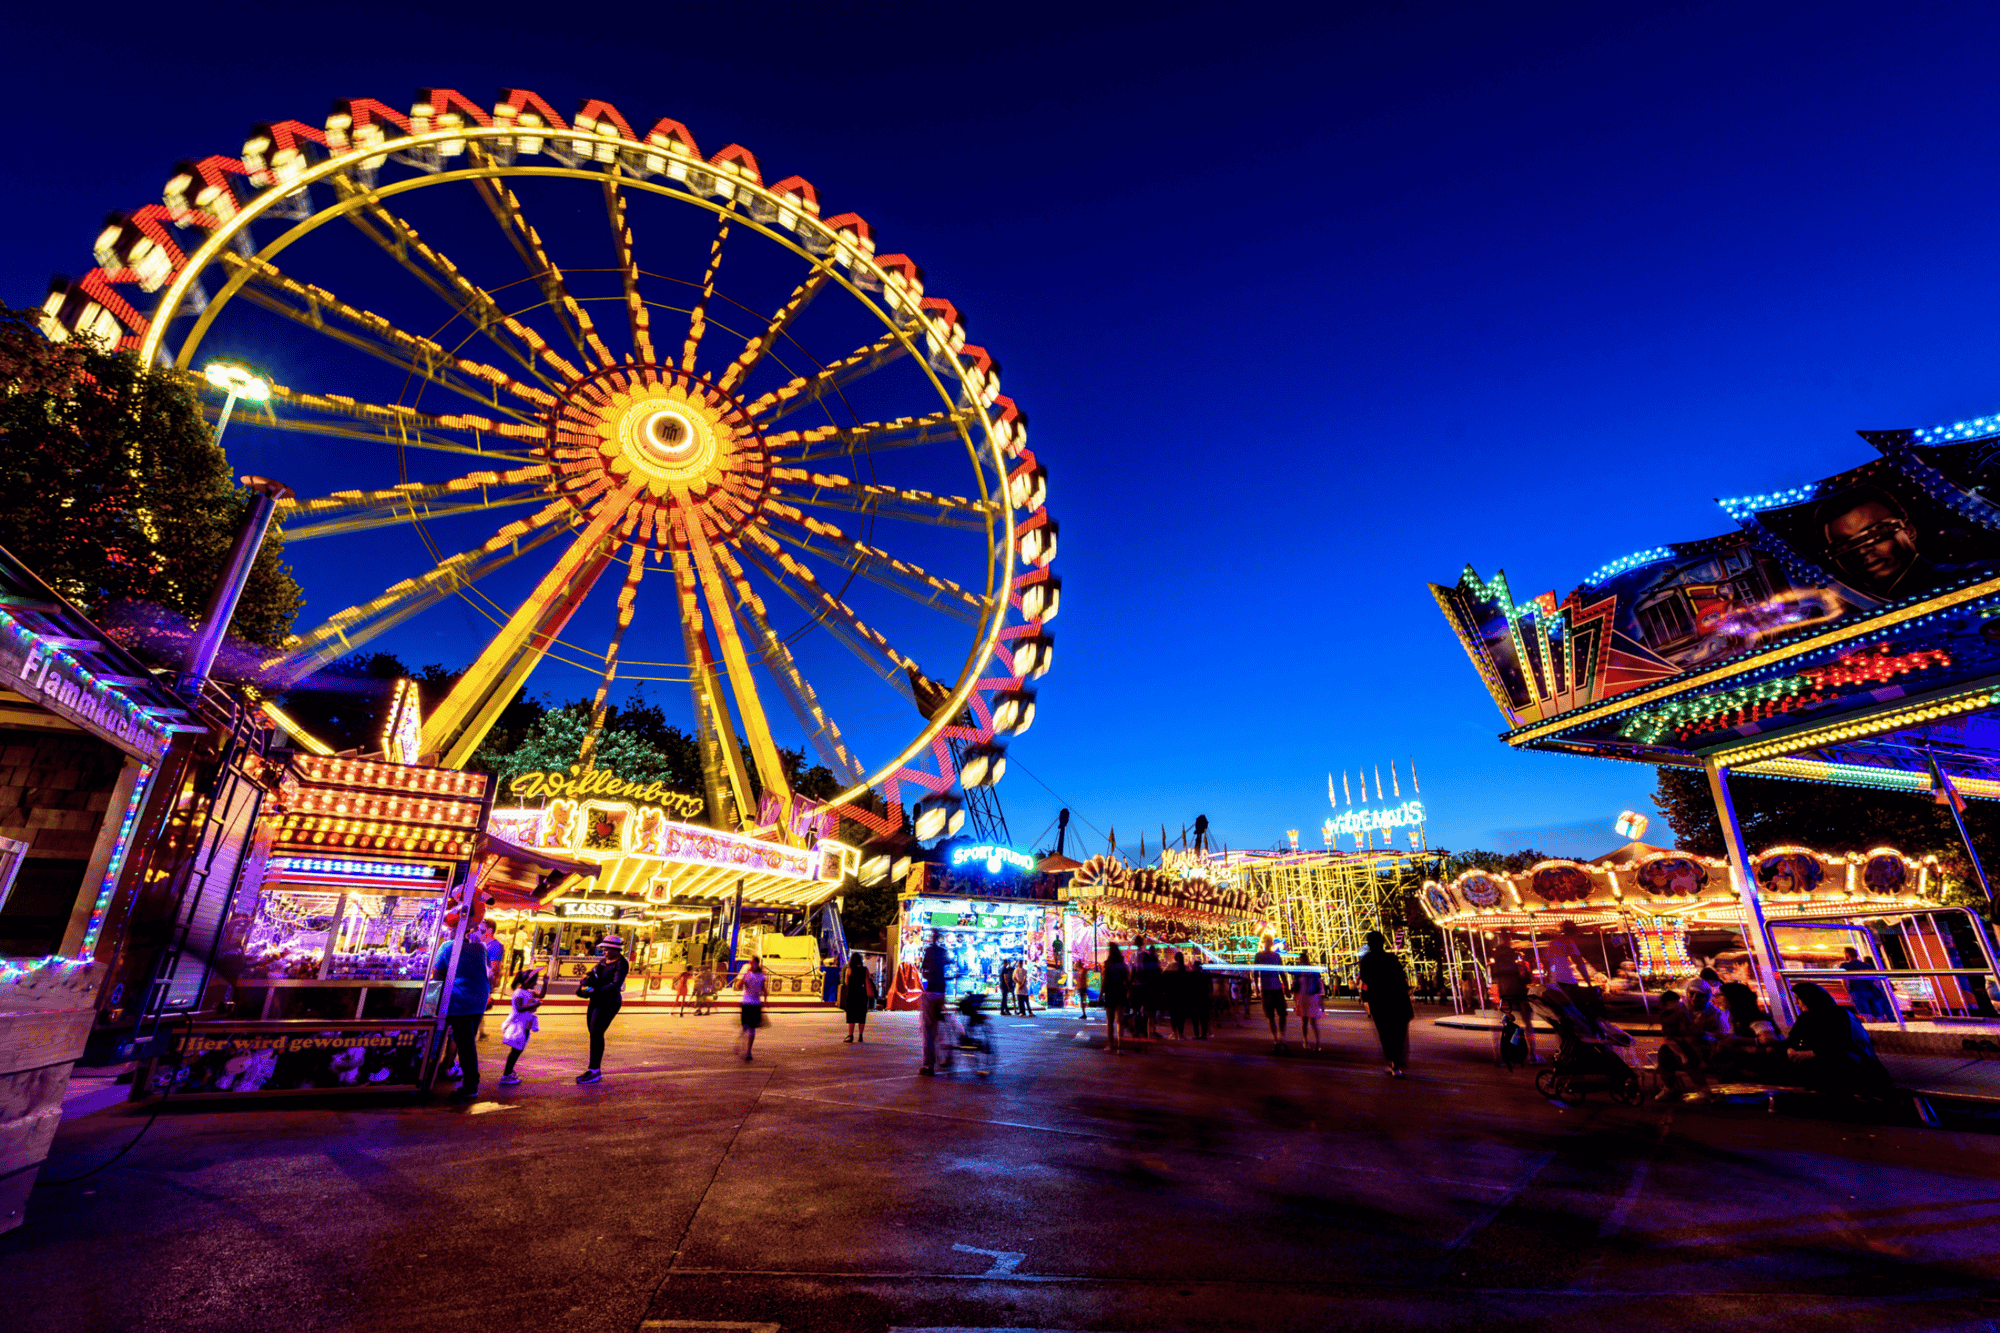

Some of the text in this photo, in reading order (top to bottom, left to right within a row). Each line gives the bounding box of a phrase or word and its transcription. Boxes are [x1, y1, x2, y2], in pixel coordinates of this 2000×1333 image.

[19, 647, 156, 754] Flammkuchen
[510, 764, 704, 818] Willenborg
[1371, 801, 1424, 830] MAUS
[952, 846, 994, 865] SPORT
[564, 902, 615, 917] KASSE
[175, 1036, 230, 1052] Hier
[234, 1035, 288, 1051] wird
[288, 1035, 393, 1052] gewonnen
